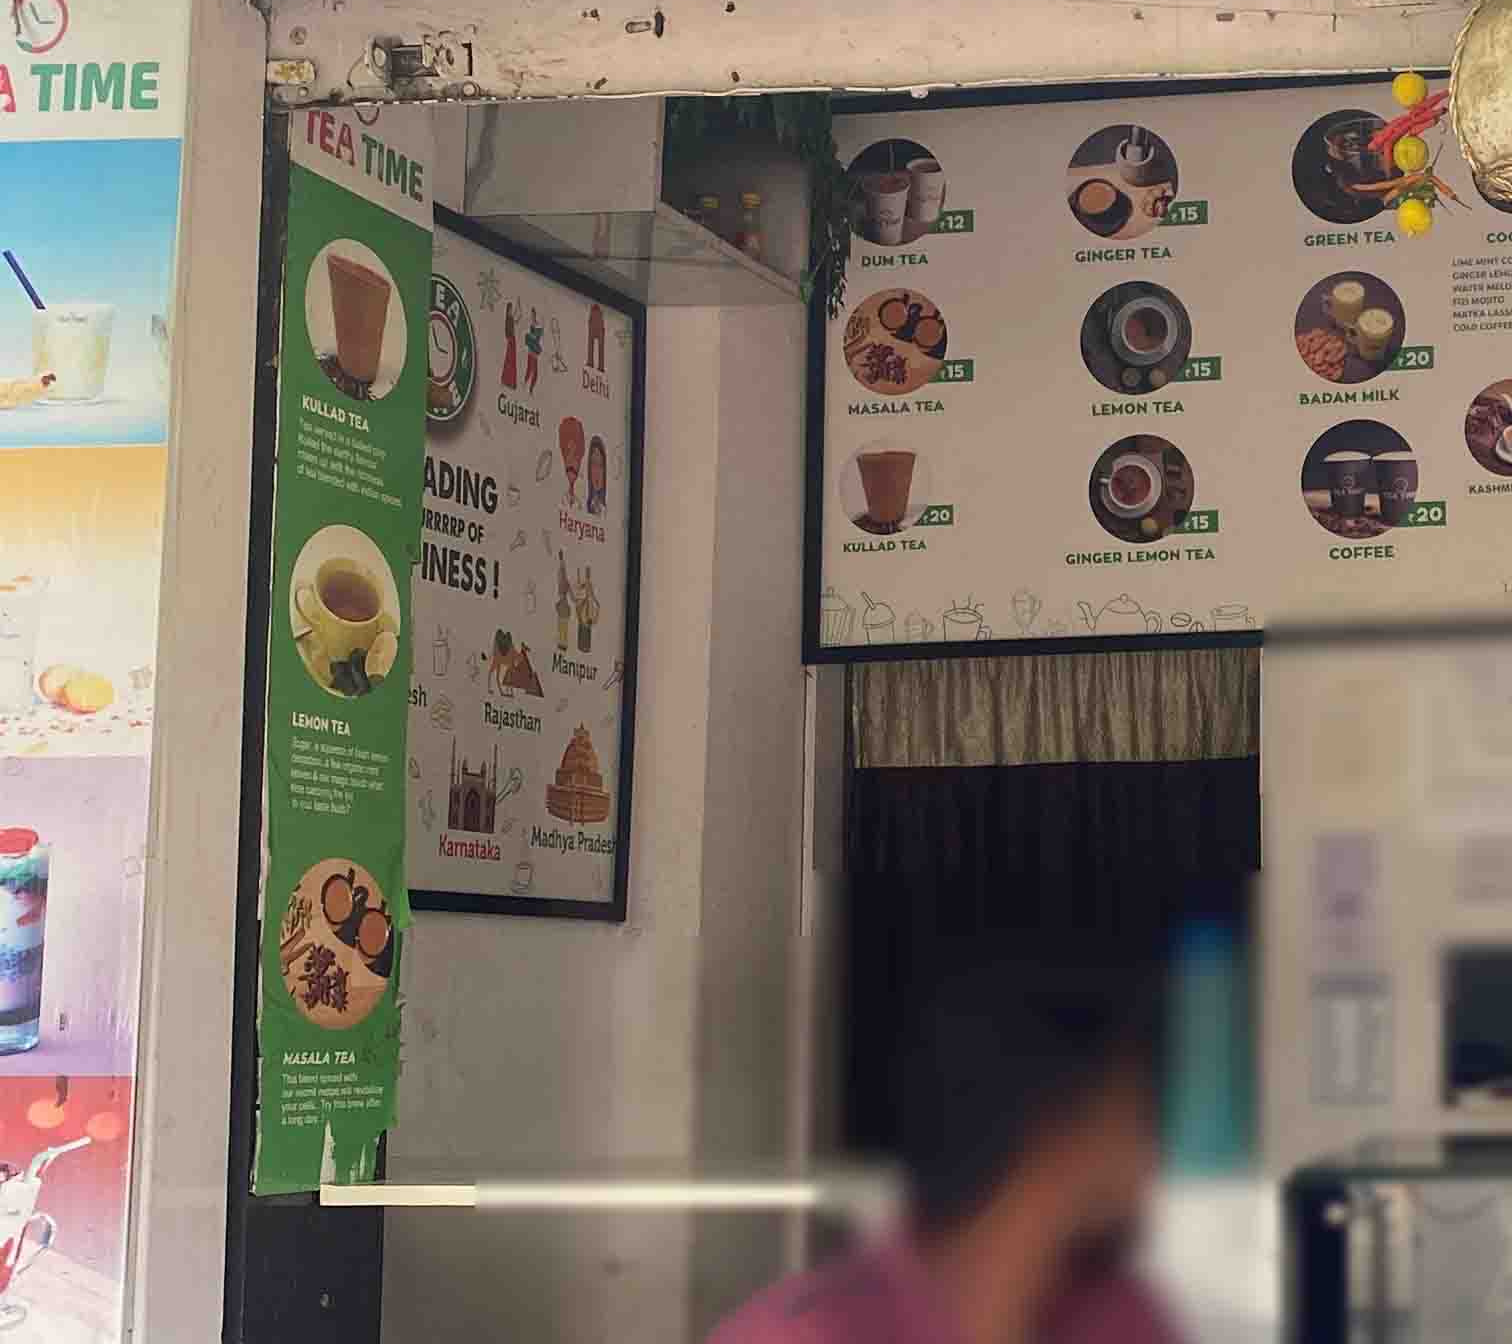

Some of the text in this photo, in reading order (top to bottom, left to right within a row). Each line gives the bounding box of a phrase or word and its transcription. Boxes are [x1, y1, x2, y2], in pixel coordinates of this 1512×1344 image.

[31, 62, 161, 113] TIME
[306, 111, 424, 203] TEA TIME
[1304, 231, 1395, 247] GREEN TEA
[899, 253, 929, 266] TEA
[1075, 246, 1173, 263] GINGER TEA
[848, 400, 945, 416] MASALA TEA
[1092, 401, 1185, 417] LEMON TEA
[1299, 389, 1401, 405] BADAM MILK
[302, 394, 369, 433] KULLAD TEA
[497, 392, 541, 428] Gujarat
[468, 521, 485, 545] OF
[559, 511, 606, 544] Haryana
[842, 540, 927, 554] KULLAD TEA
[1065, 548, 1216, 566] GINGER LEMON TEA
[1328, 545, 1395, 560] COFFEE
[552, 652, 599, 684] Manipur
[292, 711, 351, 736] LEMON TEA
[484, 702, 542, 734] Rajasthan
[438, 833, 501, 862] Karnataka
[531, 825, 575, 855] Madhya
[283, 1050, 356, 1065] MASALA TEA
